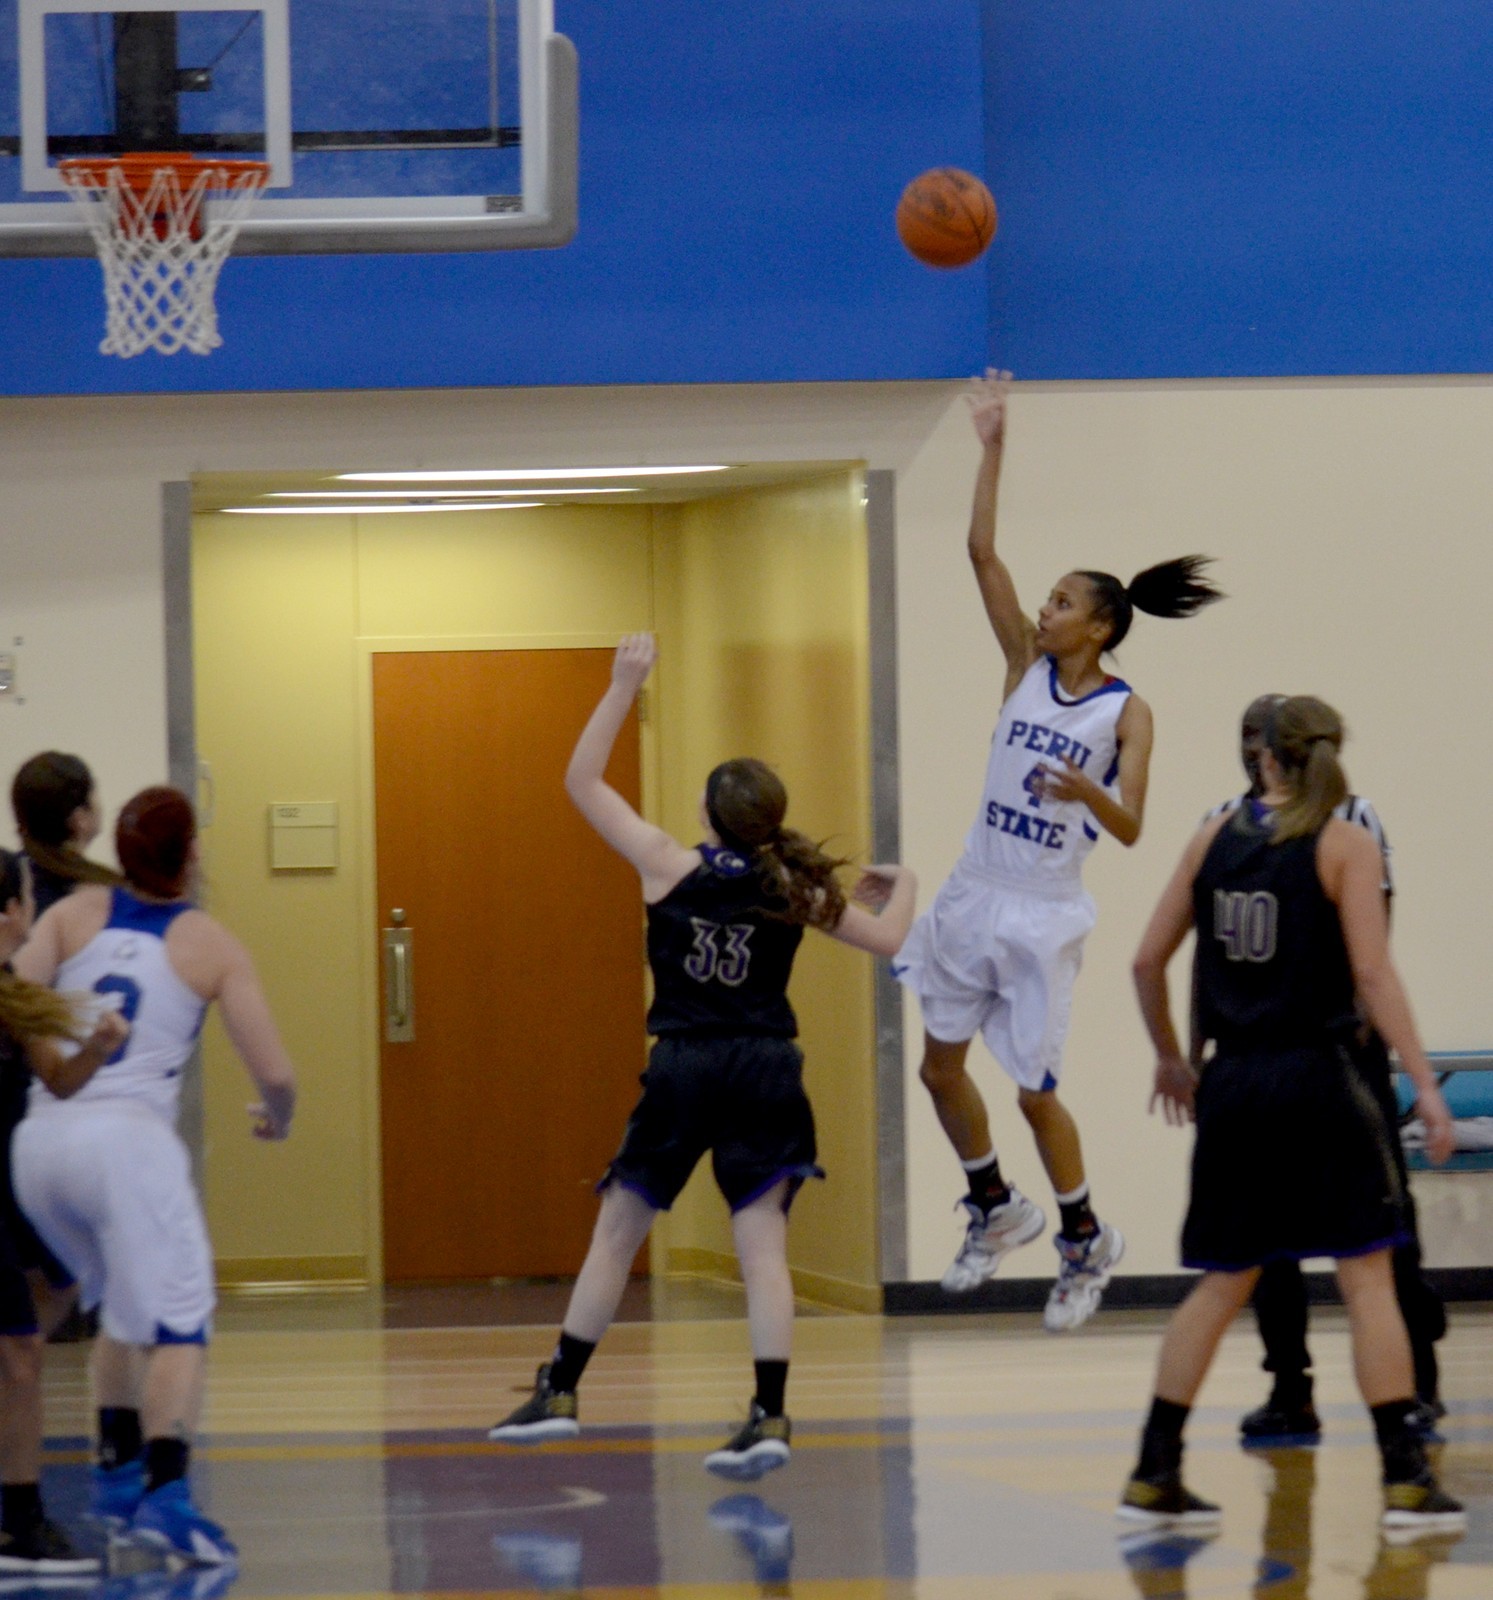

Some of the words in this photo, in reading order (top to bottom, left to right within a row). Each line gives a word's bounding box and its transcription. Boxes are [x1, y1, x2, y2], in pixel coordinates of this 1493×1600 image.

[1007, 720, 1092, 769] PERU
[986, 801, 1066, 850] STATE
[684, 916, 756, 987] 33
[1213, 888, 1279, 962] 40
